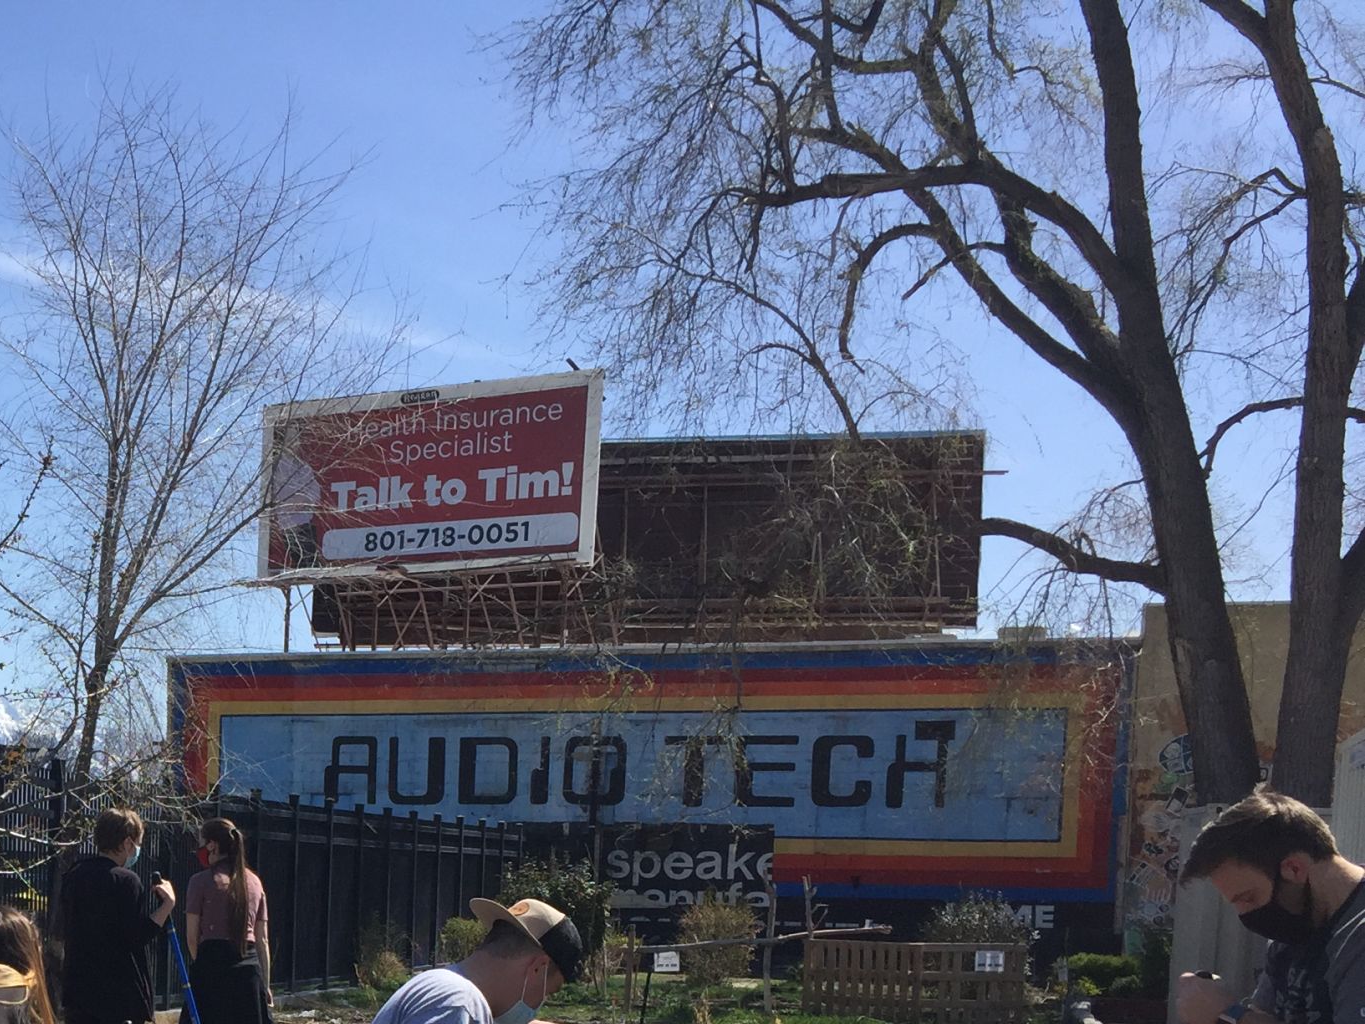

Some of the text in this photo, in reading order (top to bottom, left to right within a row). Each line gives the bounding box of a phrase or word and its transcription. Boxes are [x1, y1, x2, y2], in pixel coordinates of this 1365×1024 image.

[436, 402, 564, 431] Insurance
[389, 431, 513, 465] Specialist
[331, 462, 574, 513] Talk to Tim!
[364, 520, 530, 553] 801-718-0051
[324, 720, 956, 808] AUDIO TECH
[607, 843, 773, 886] speake
